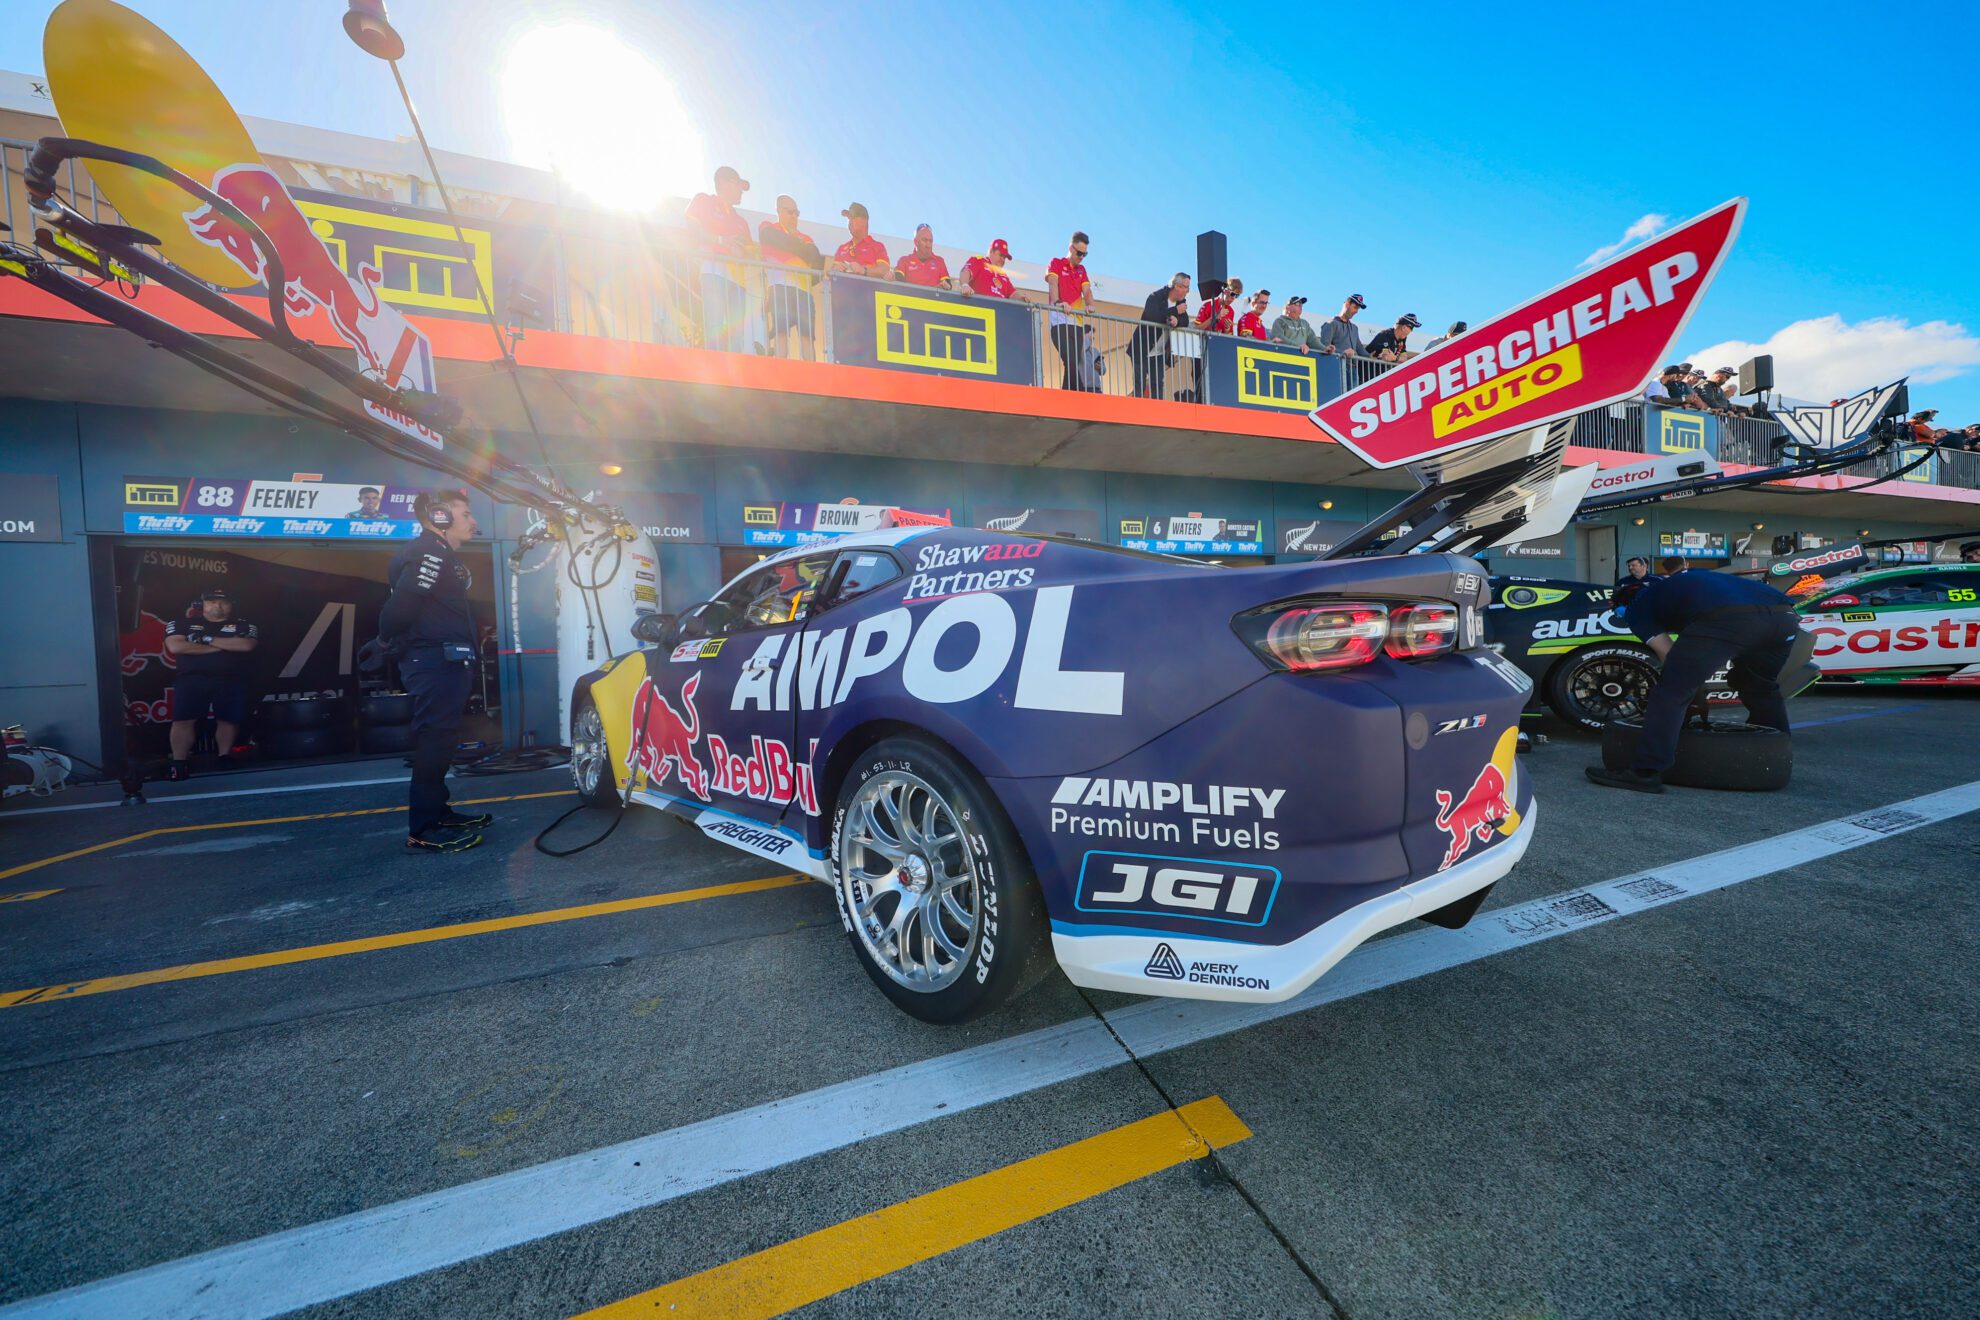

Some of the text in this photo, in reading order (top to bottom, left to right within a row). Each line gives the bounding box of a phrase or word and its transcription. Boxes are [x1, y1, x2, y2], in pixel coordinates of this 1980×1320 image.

[1349, 251, 1699, 438] SUPERCHEAP
[1447, 362, 1563, 426] AUTO
[1591, 467, 1655, 489] Castrol
[197, 486, 234, 507] 88
[252, 488, 319, 509] FEENEY
[138, 516, 193, 532] Thrifty
[212, 518, 266, 533] Thrifty
[283, 520, 333, 535] Thrifty
[349, 521, 397, 536] Thrifty
[794, 508, 802, 525] 1
[820, 509, 859, 526] BROWN
[752, 531, 786, 544] Thrifty
[1153, 521, 1162, 535] 6
[1172, 522, 1202, 536] WATERS
[158, 552, 186, 569] YOU
[1789, 545, 1862, 572] Castrol
[903, 567, 1035, 600] Partners
[1948, 588, 1977, 602] 55
[730, 585, 1124, 715] AMPOL
[1082, 778, 1286, 819] AMPLIFY
[1051, 807, 1280, 851] Premium Fuels
[1092, 863, 1259, 915] JGI
[1190, 962, 1239, 975] AVERY
[1189, 973, 1270, 990] DENNISON
